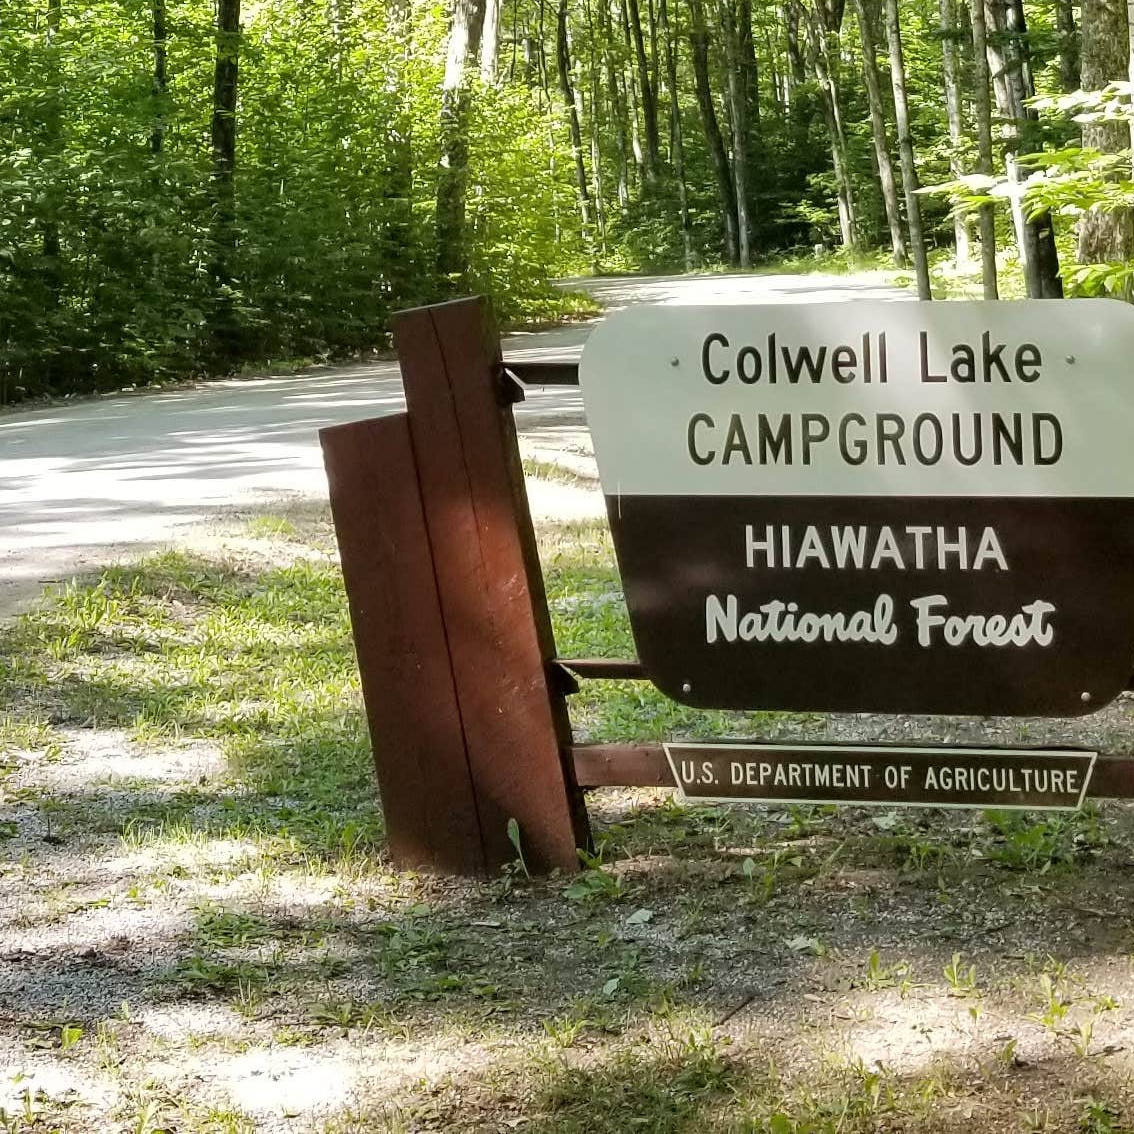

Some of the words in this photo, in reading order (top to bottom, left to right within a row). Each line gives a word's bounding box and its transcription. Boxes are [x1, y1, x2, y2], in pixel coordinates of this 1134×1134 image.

[702, 332, 888, 384] Colwell
[919, 331, 1042, 383] Lake
[687, 412, 1063, 466] CAMPGROUND
[745, 525, 1009, 570] HIAWATHA
[705, 593, 897, 645] National
[910, 594, 1055, 647] Forest
[681, 760, 718, 784] U.S.
[731, 761, 871, 788] DEPARTMENT
[884, 766, 912, 789] OF
[924, 766, 1079, 794] AGRICULTURE
